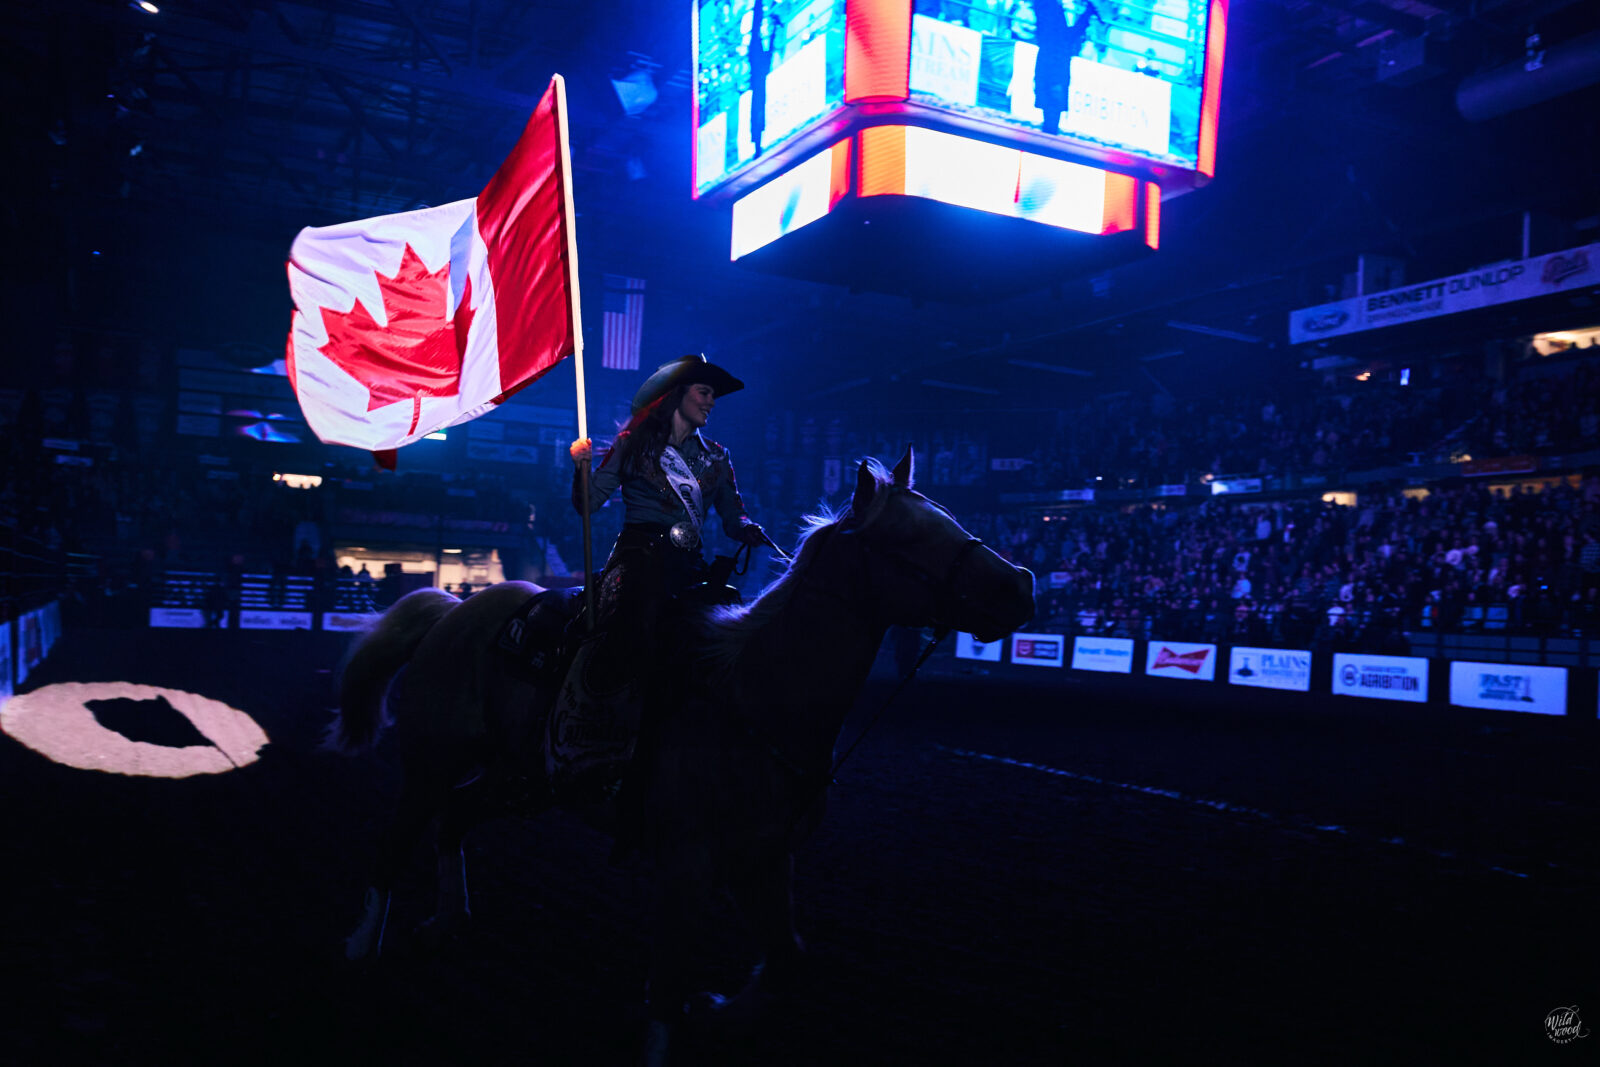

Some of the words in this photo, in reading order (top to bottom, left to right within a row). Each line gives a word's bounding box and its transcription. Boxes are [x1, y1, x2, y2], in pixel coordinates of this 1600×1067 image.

[1366, 281, 1447, 311] BENNETT
[1448, 264, 1526, 294] DUNLOP
[1261, 654, 1308, 669] PLAINS
[1360, 673, 1419, 691] AGRIBITION
